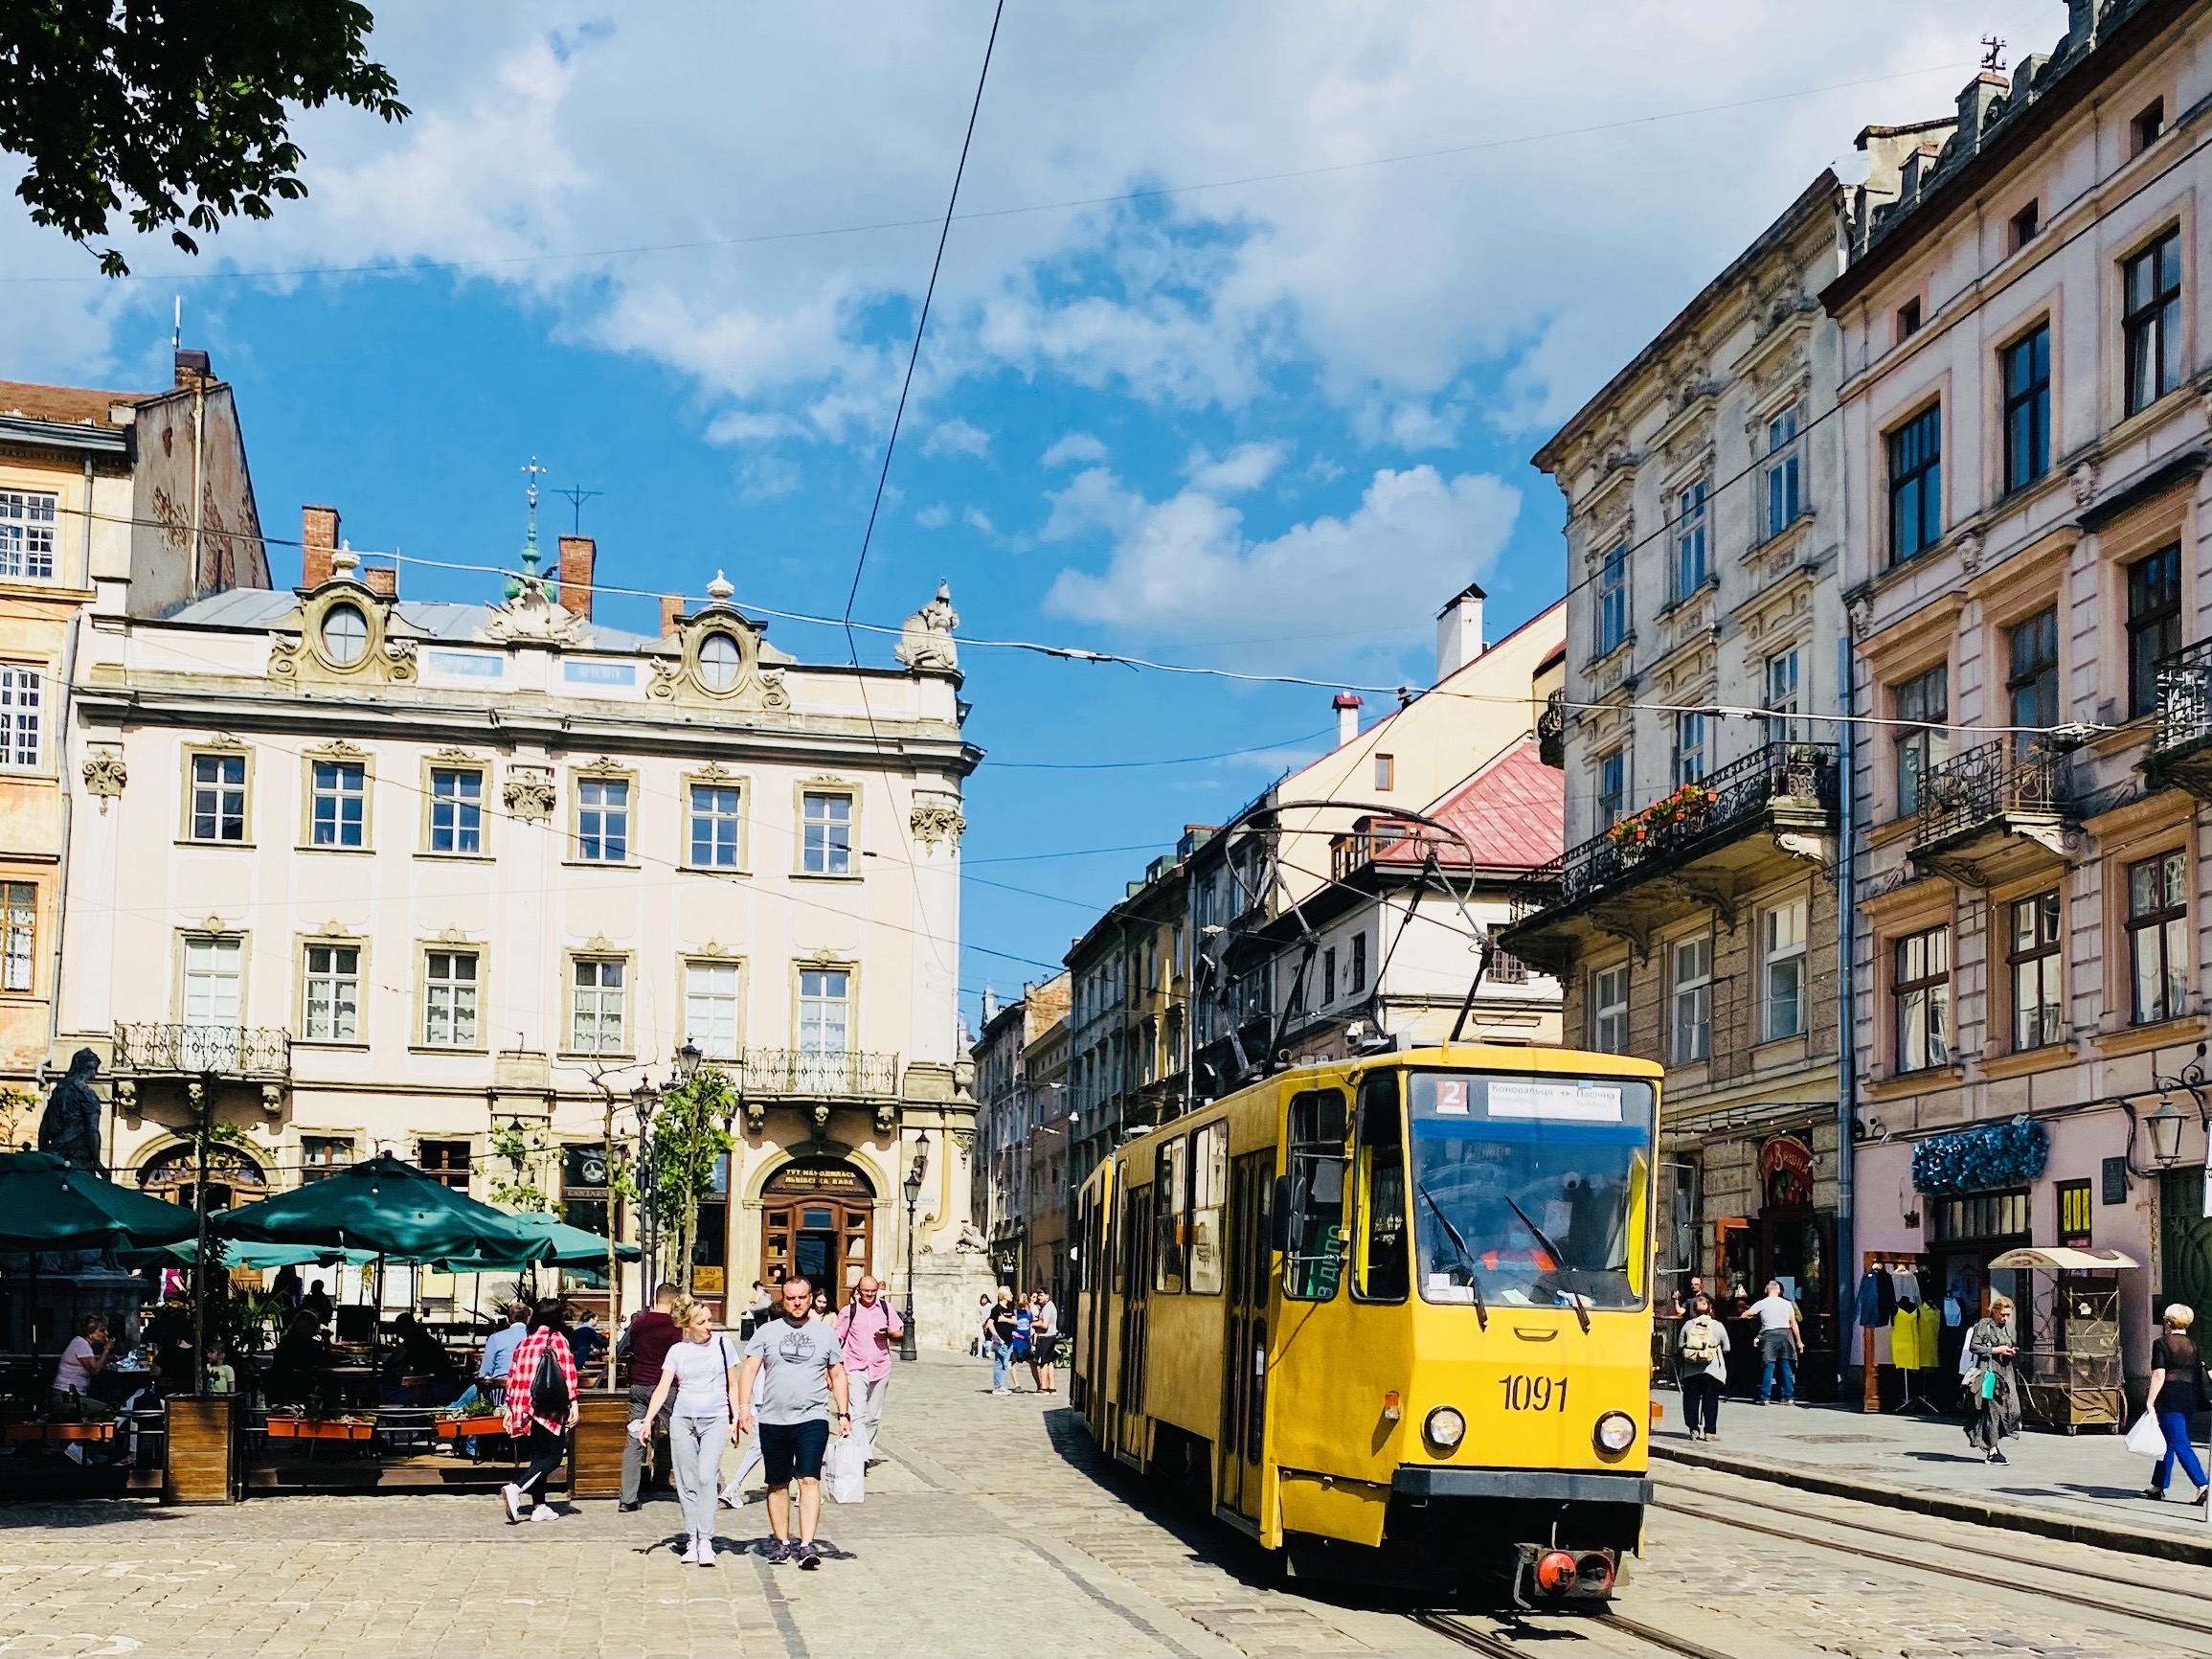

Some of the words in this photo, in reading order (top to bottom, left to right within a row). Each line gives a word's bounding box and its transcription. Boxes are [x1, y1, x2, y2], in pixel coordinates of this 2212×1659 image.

[1443, 1080, 1461, 1104] 2
[1492, 1083, 1553, 1097] Коновальця
[1576, 1088, 1615, 1101] Пасічна
[1498, 1375, 1568, 1412] 1091
